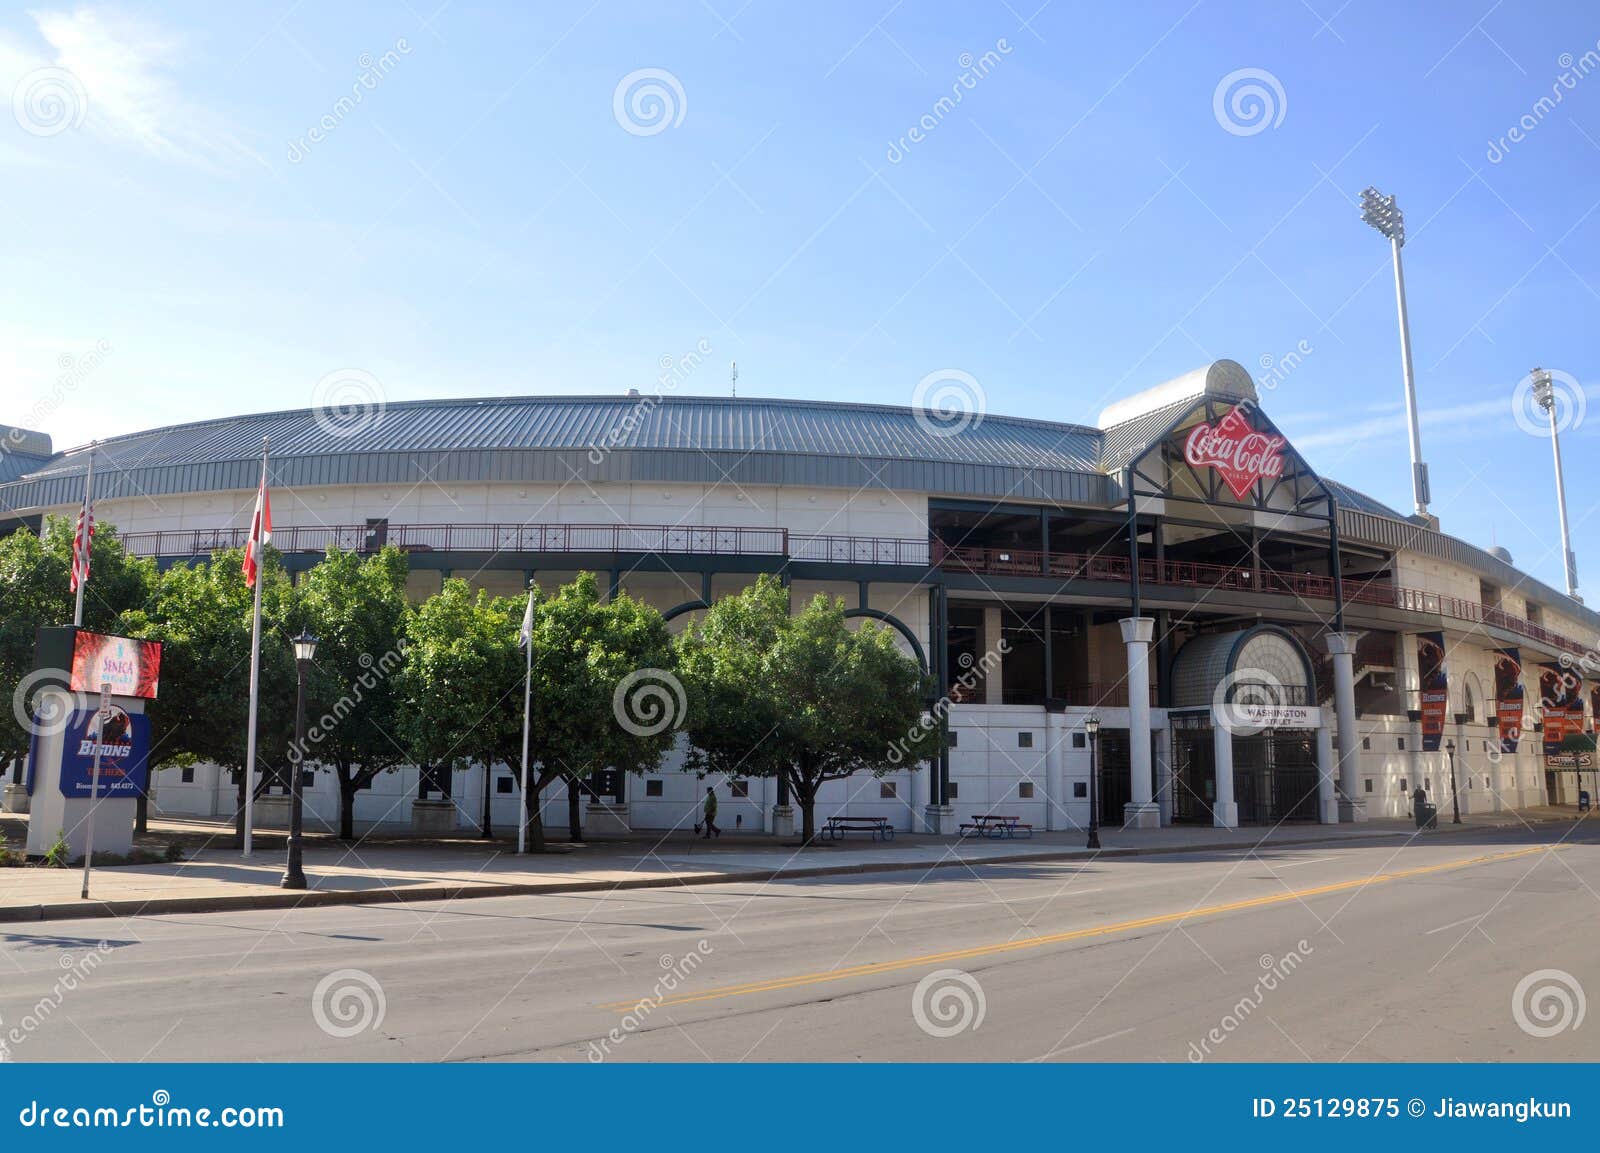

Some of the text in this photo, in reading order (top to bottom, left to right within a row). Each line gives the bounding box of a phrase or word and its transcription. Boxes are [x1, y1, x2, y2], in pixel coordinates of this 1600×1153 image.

[1185, 424, 1284, 476] Coca-Cola
[103, 657, 133, 675] SENECA
[1248, 708, 1307, 718] WASHINGTON
